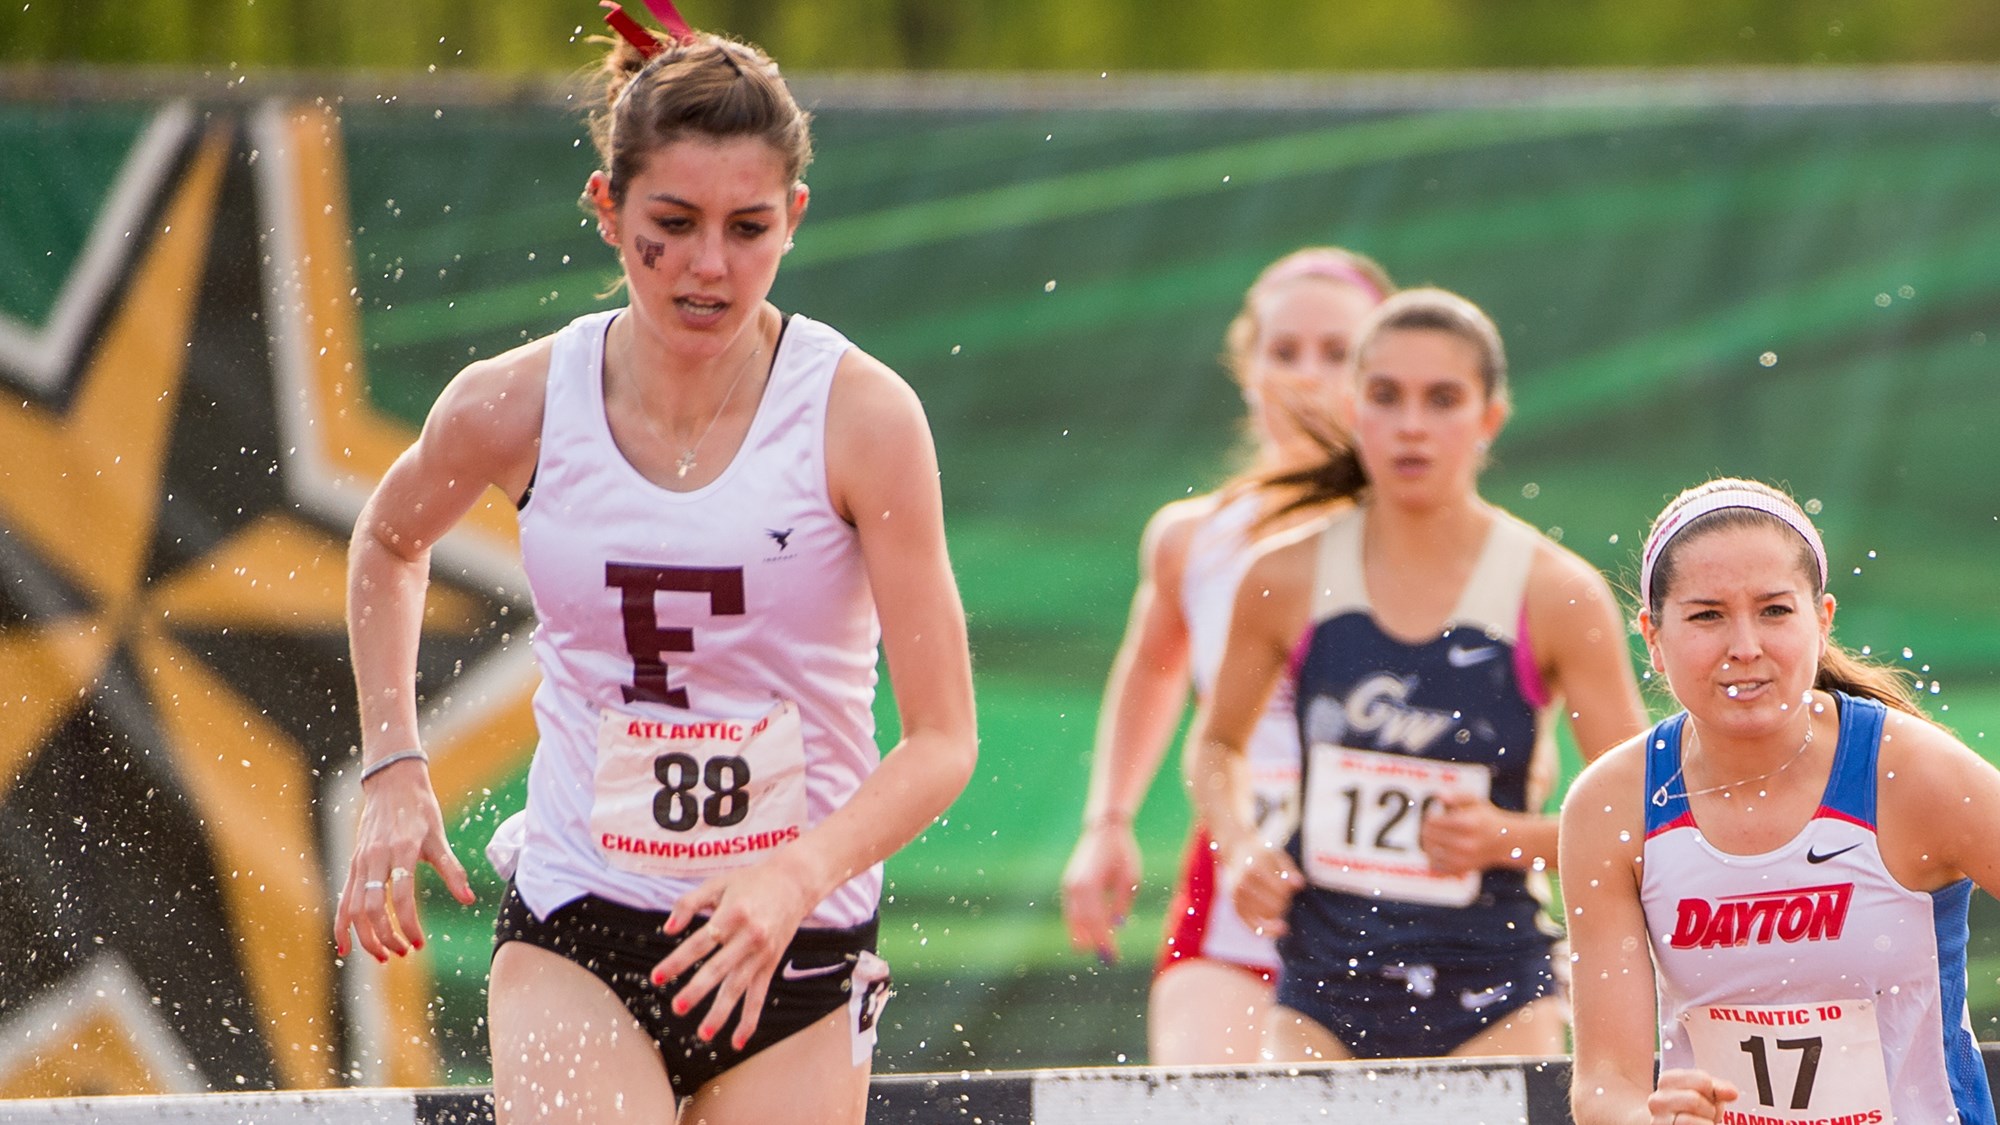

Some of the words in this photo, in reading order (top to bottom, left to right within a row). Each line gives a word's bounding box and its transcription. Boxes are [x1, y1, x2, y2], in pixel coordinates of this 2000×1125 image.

[605, 561, 745, 709] F
[627, 720, 743, 742] ATLANTIC
[653, 752, 750, 832] 88
[601, 825, 800, 859] CHAMPIONSHIPS
[1670, 882, 1855, 949] DAYTON
[1709, 1008, 1810, 1026] ATLANTIC
[1816, 1005, 1842, 1021] 10
[1740, 1035, 1823, 1110] 17
[1723, 1109, 1883, 1125] HAMPSHIPS
